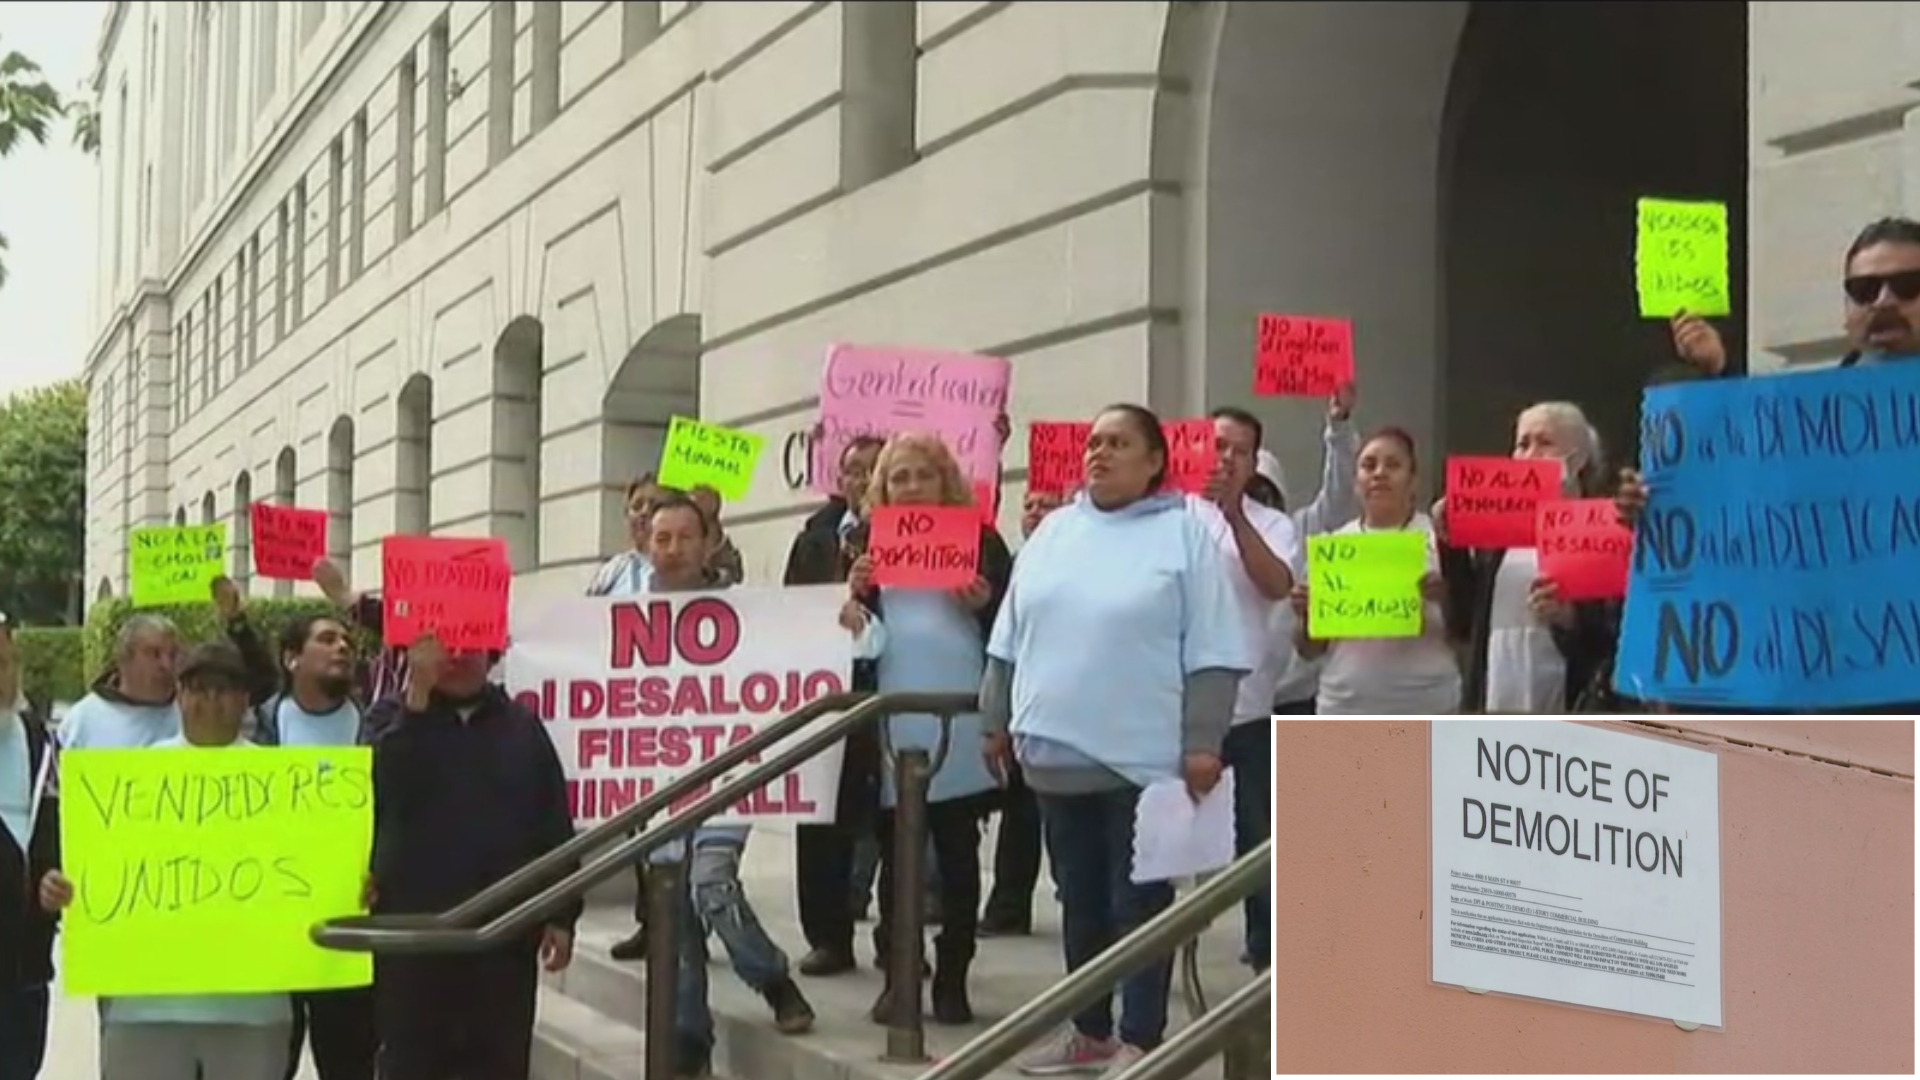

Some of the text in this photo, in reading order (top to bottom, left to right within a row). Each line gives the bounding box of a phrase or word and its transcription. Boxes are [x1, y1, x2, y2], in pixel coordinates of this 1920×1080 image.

[1460, 466, 1485, 490] NO
[897, 511, 934, 538] NO
[1542, 508, 1609, 530] NO AL
[1634, 505, 1696, 577] NO
[870, 545, 975, 572] DEMOLITION
[1315, 542, 1355, 563] NO
[1322, 571, 1351, 593] AL
[610, 597, 740, 669] NO
[1652, 601, 1740, 686] NO
[568, 669, 844, 720] DESALOJO
[577, 723, 765, 770] FIESTA
[1477, 737, 1670, 812] NOTICE OF
[1463, 797, 1683, 878] DEMOLITION
[80, 856, 312, 923] UNIDOS
[1486, 901, 1505, 909] POSTING
[1550, 912, 1577, 922] COMMERCIAL
[1578, 917, 1599, 925] BUILDING
